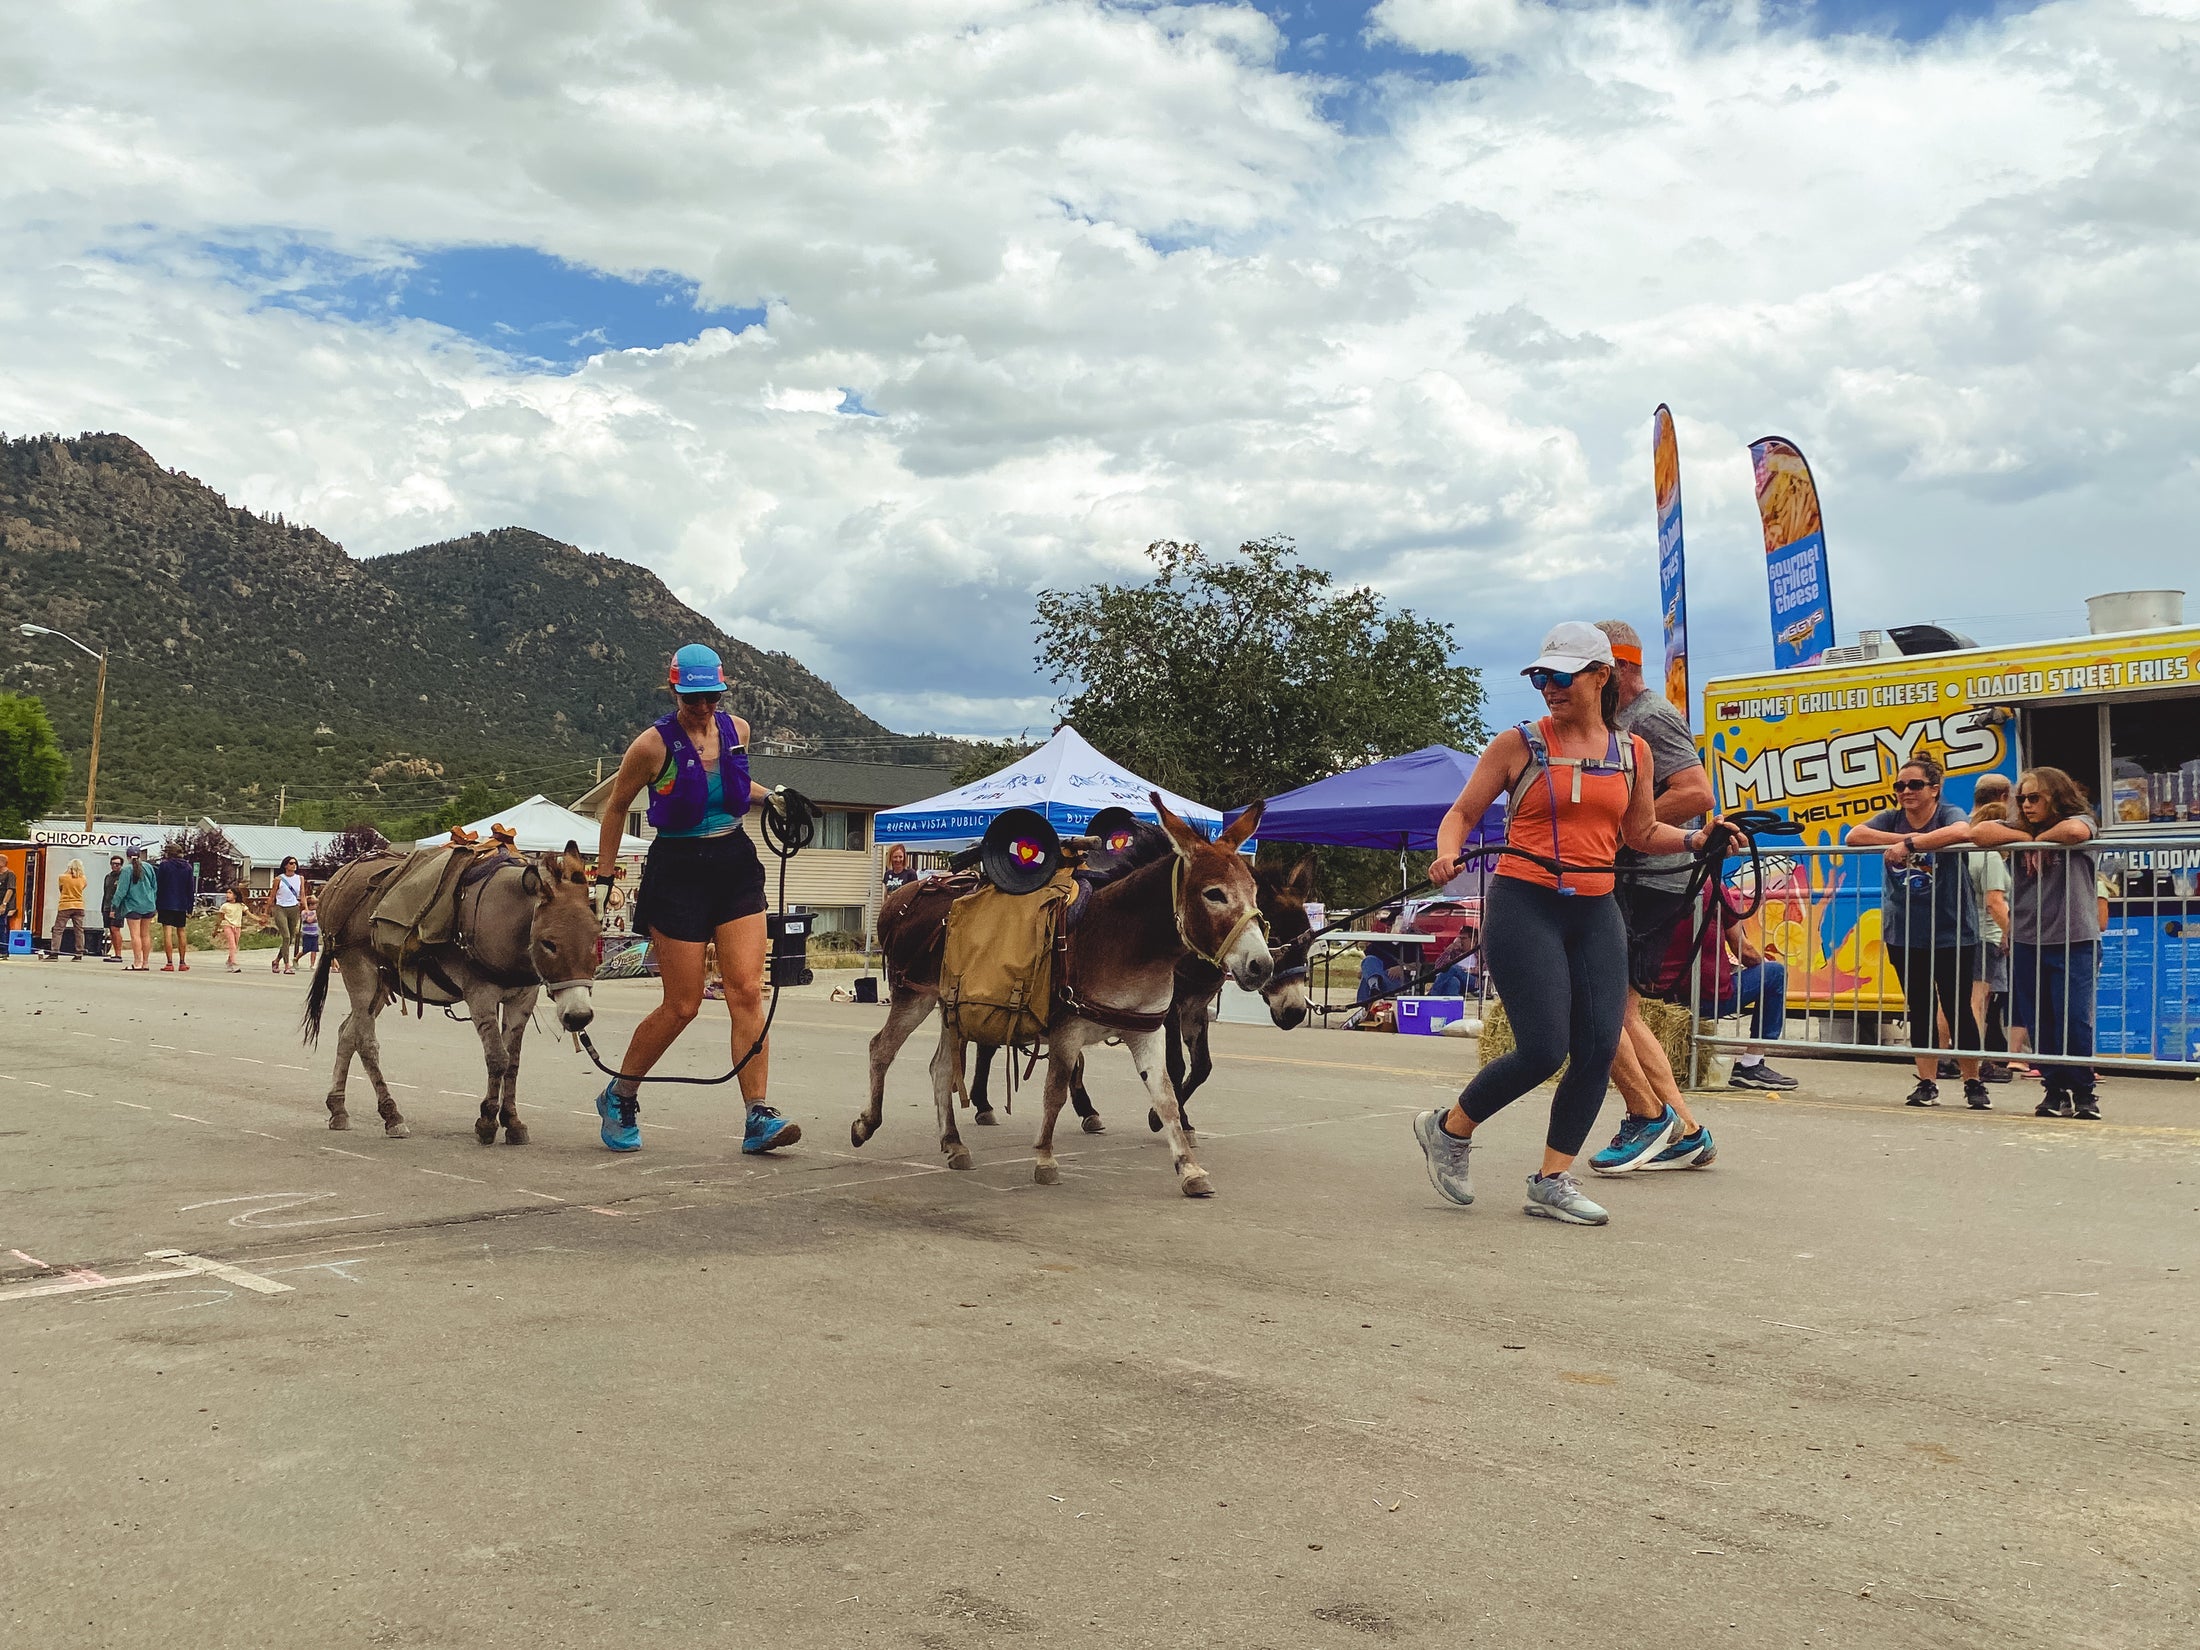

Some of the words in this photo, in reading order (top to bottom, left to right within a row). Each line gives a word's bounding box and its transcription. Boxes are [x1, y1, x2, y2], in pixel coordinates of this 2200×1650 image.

[1798, 687, 1869, 714] GRILLED
[1872, 681, 1939, 708] CHEESE
[1966, 671, 2043, 699] LOADED
[2047, 663, 2123, 691] STREET
[2127, 656, 2189, 684] FRIES
[1720, 707, 1998, 810] MIGGY'S
[35, 831, 141, 848] CHIROPRACTIC
[886, 822, 918, 832] BUENA
[921, 818, 947, 830] VISTA
[951, 815, 984, 828] PUBLIC
